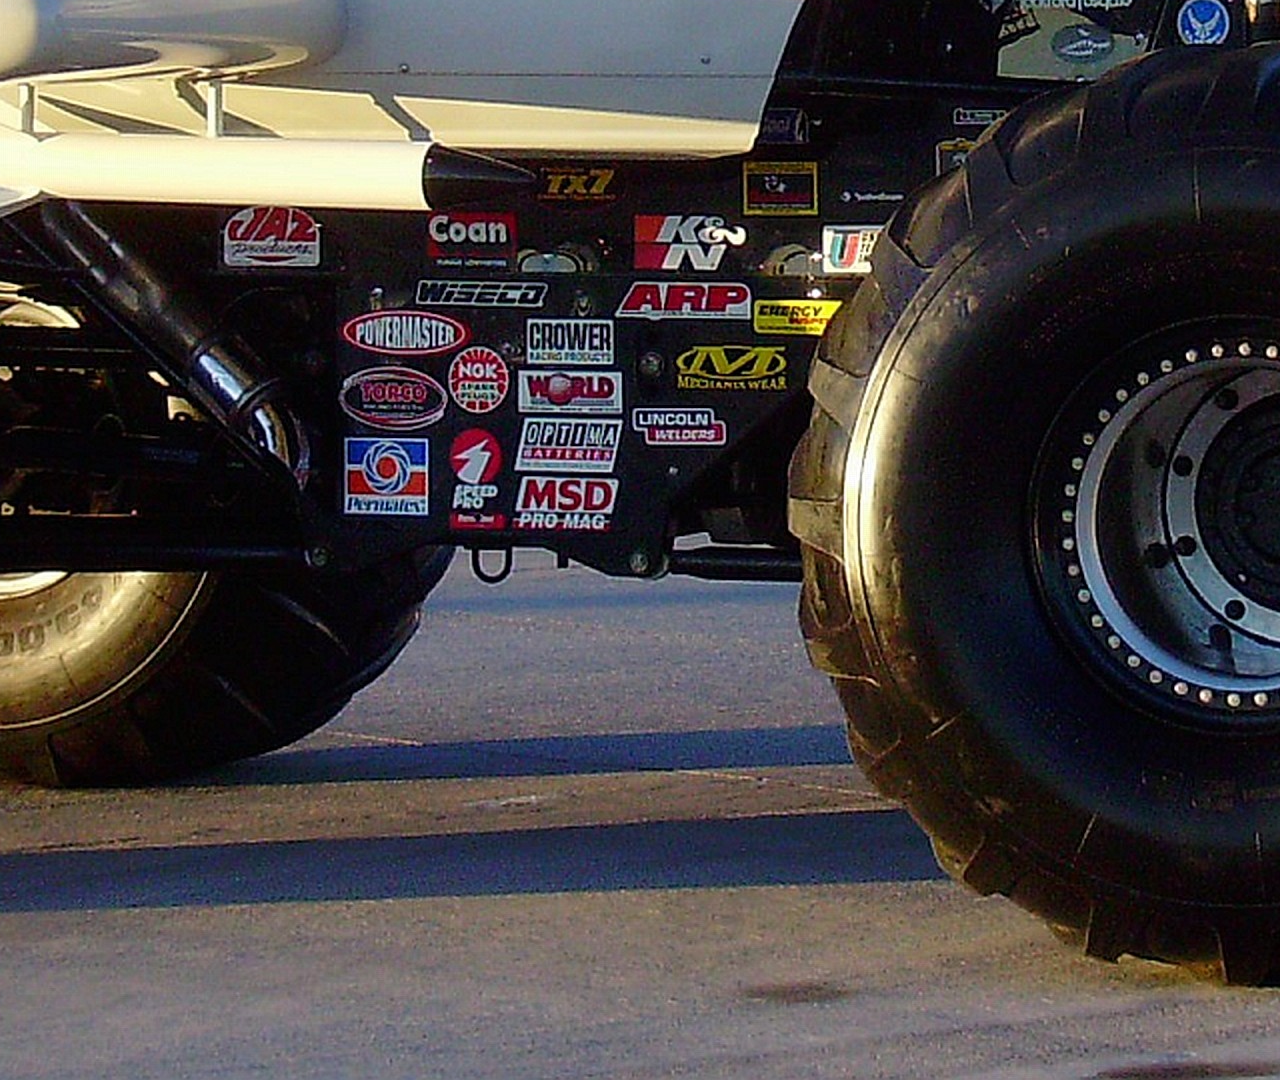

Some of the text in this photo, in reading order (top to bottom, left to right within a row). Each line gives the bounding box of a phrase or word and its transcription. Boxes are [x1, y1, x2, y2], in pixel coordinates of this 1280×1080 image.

[227, 206, 317, 242] JAZ
[429, 215, 507, 243] Coan
[622, 283, 749, 313] ARP
[355, 315, 456, 348] POWERMASTER
[529, 322, 612, 351] CROWER
[458, 363, 498, 379] NGK
[360, 381, 428, 403] TORCO
[527, 374, 616, 403] WORLD
[677, 375, 787, 390] MECHANIX WEAR
[638, 413, 709, 426] LINCOLN
[527, 423, 615, 446] OPTIMA
[654, 429, 717, 441] WELDERS
[522, 449, 612, 459] BATTERIES
[455, 484, 499, 498] SPEED
[521, 479, 613, 511] MSD
[453, 496, 484, 509] PRO
[519, 513, 606, 529] PRO MAG
